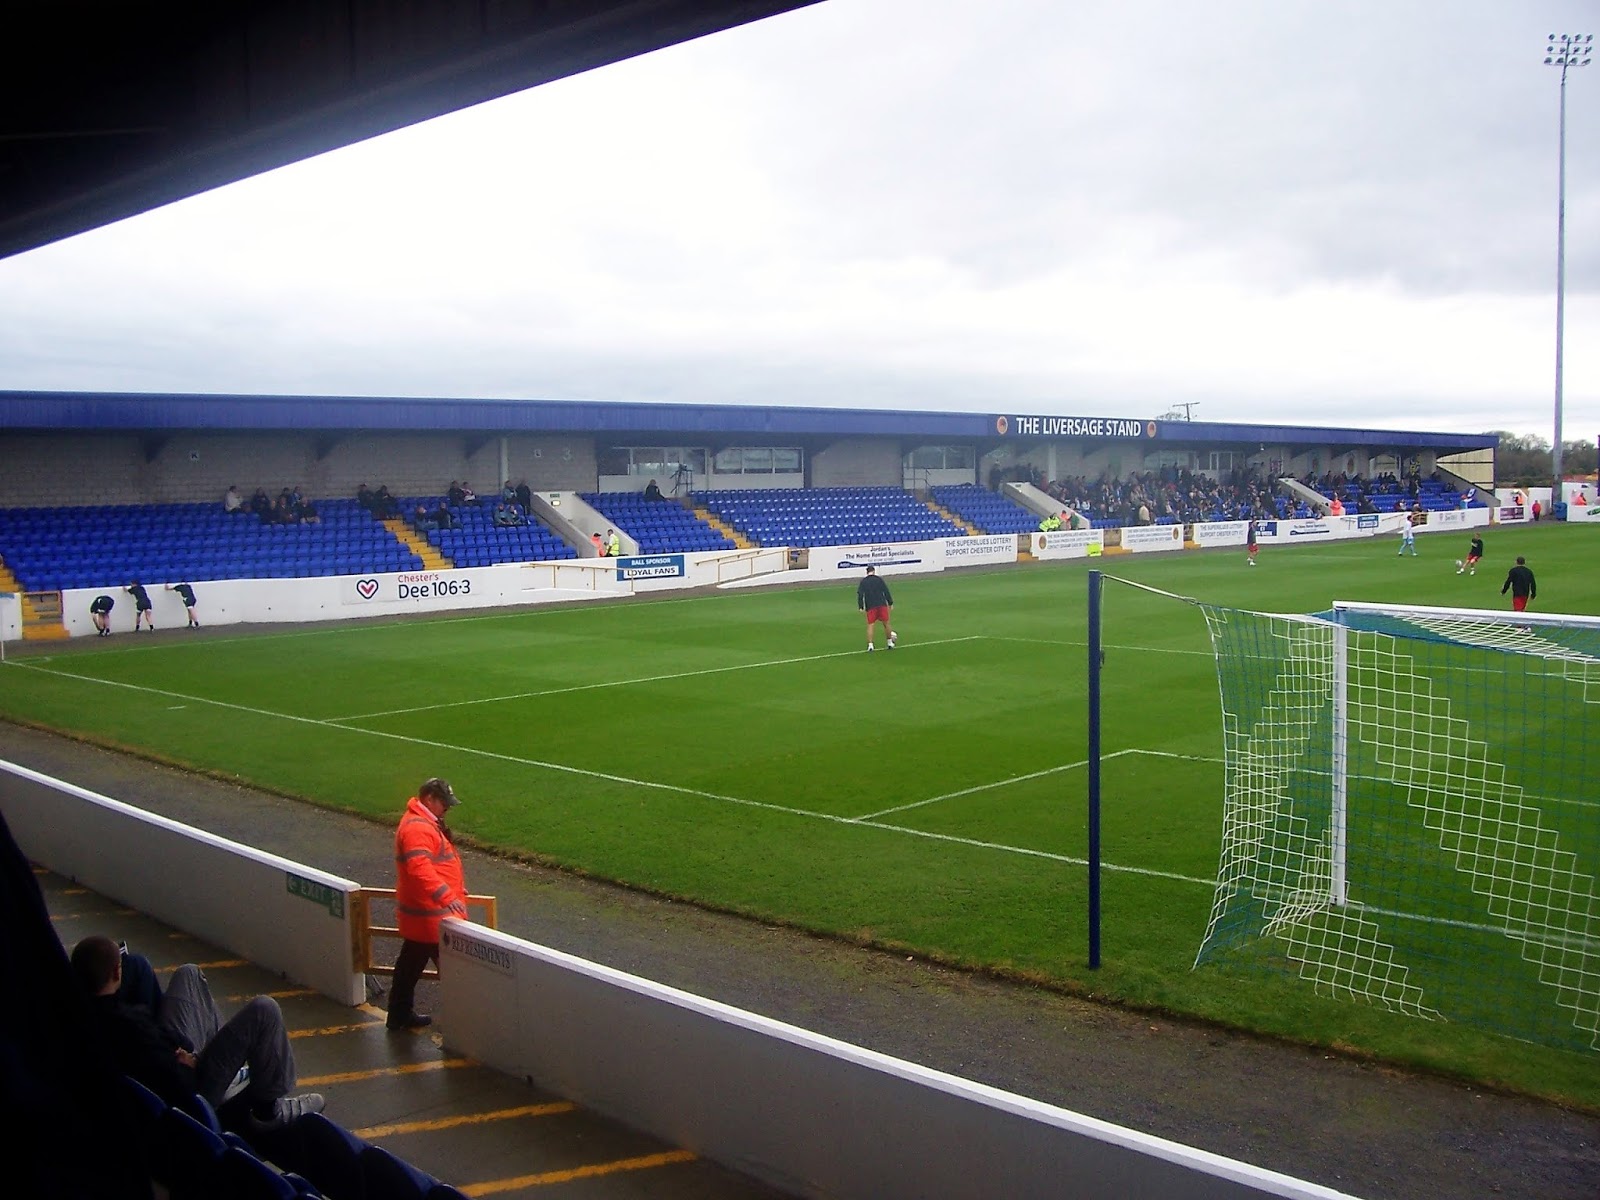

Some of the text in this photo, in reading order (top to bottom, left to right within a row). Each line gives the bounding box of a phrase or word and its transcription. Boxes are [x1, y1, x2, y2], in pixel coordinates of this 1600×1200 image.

[1016, 417, 1142, 437] THE LIVERSAGE STAND
[945, 540, 956, 548] THE
[990, 537, 1012, 545] LOTTERY
[888, 549, 915, 557] Specialists
[945, 547, 969, 556] SUPPORT
[969, 546, 993, 554] CHESTER
[993, 545, 1004, 553] CITY
[645, 557, 671, 565] SPONSOR
[627, 567, 676, 576] LOYAL FANS
[397, 573, 440, 583] Chester's
[398, 583, 430, 599] Dee
[451, 934, 511, 969] REFRESHMENTS
